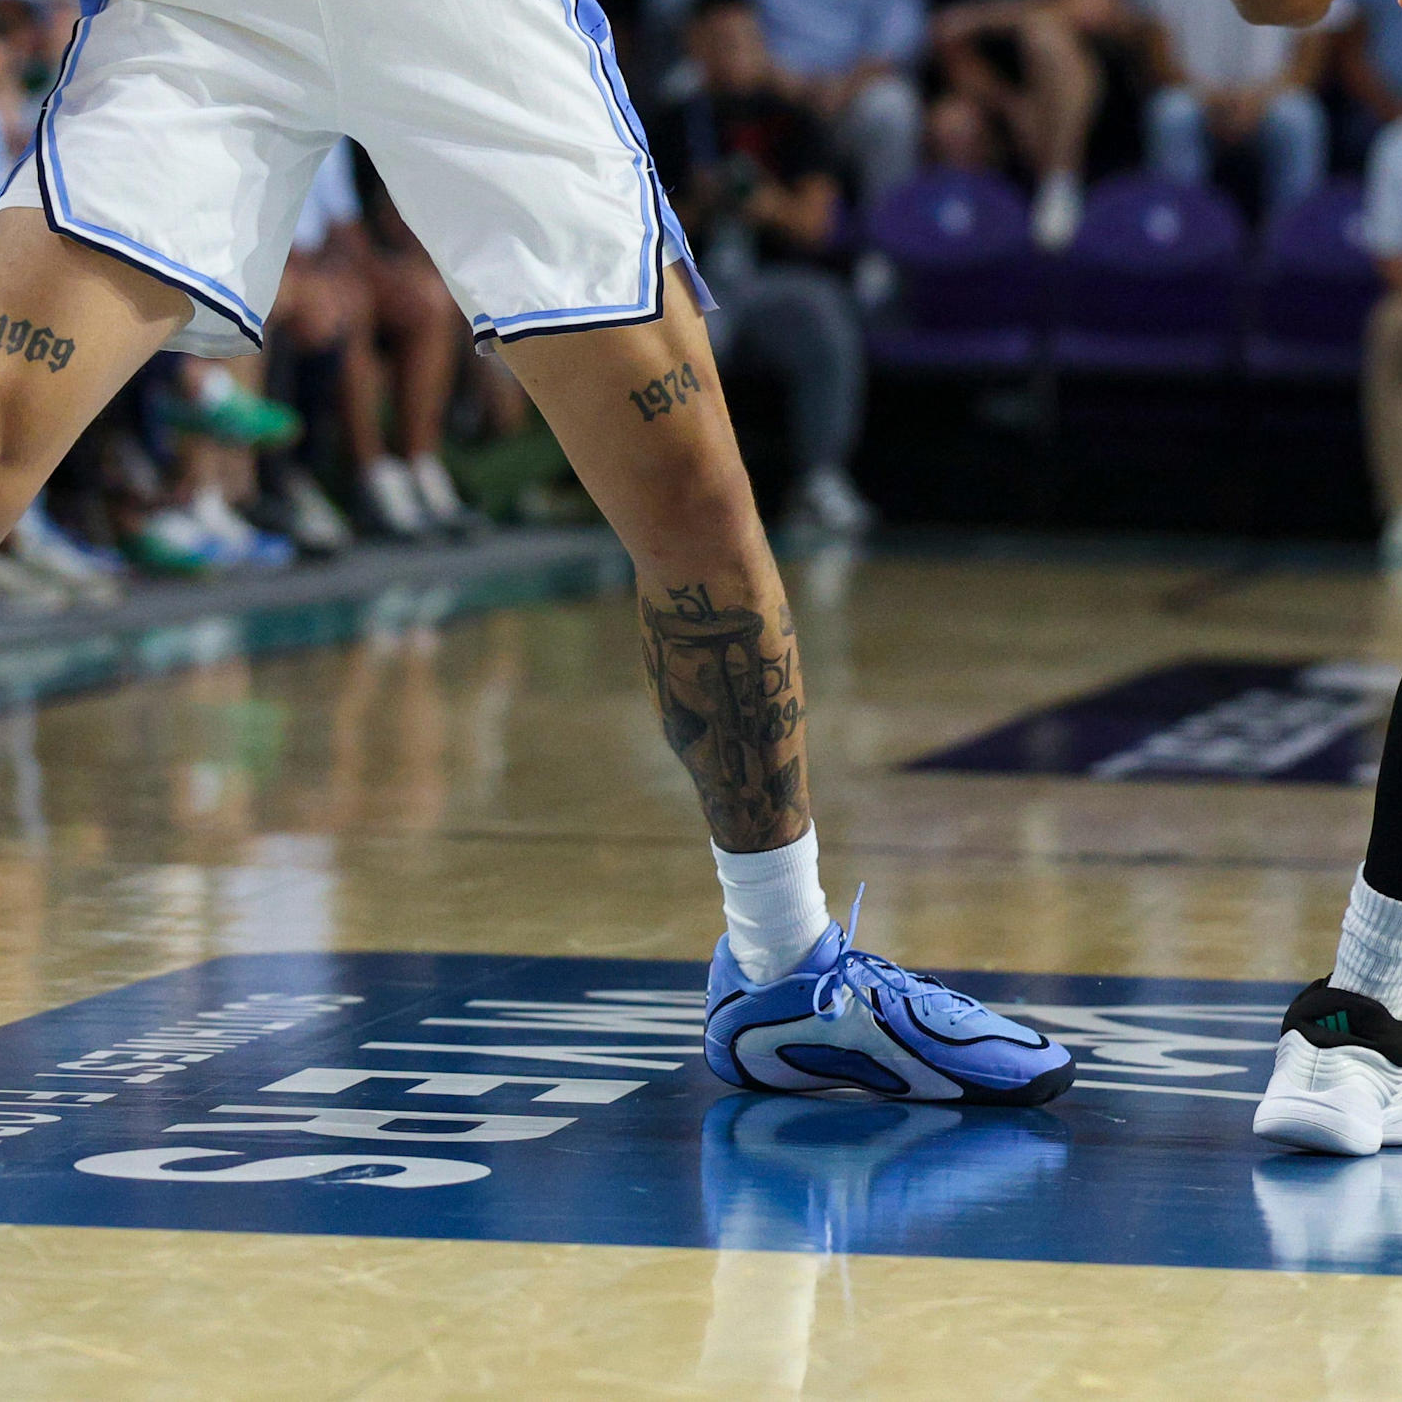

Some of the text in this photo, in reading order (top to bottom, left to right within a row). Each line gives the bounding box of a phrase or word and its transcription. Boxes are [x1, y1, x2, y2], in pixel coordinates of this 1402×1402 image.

[630, 362, 700, 423] 1974
[35, 992, 365, 1085] SOUTHWEST
[73, 996, 706, 1189] MYERS
